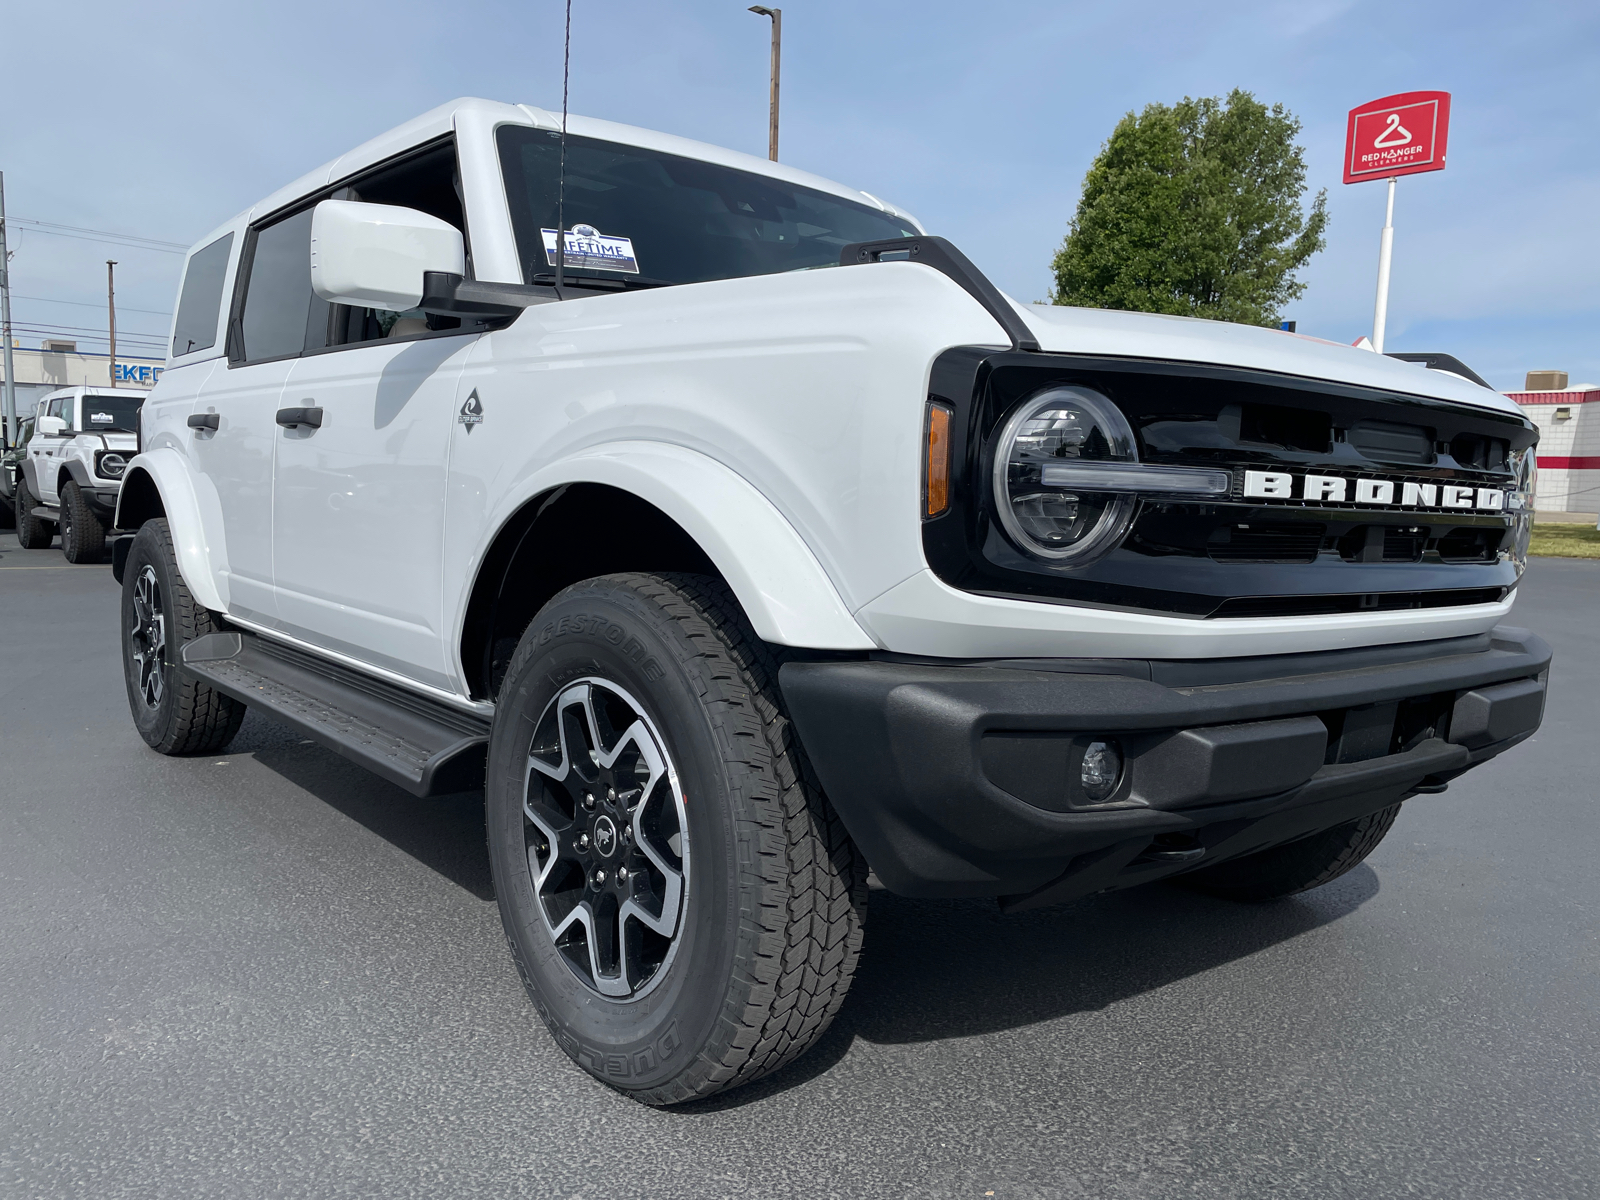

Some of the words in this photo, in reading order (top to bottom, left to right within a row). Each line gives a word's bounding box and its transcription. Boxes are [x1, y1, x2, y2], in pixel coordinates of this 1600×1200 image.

[1361, 152, 1380, 162] RED
[1368, 155, 1414, 167] CLEANERS
[555, 239, 624, 256] IFETIME
[1243, 469, 1503, 510] BRONCO
